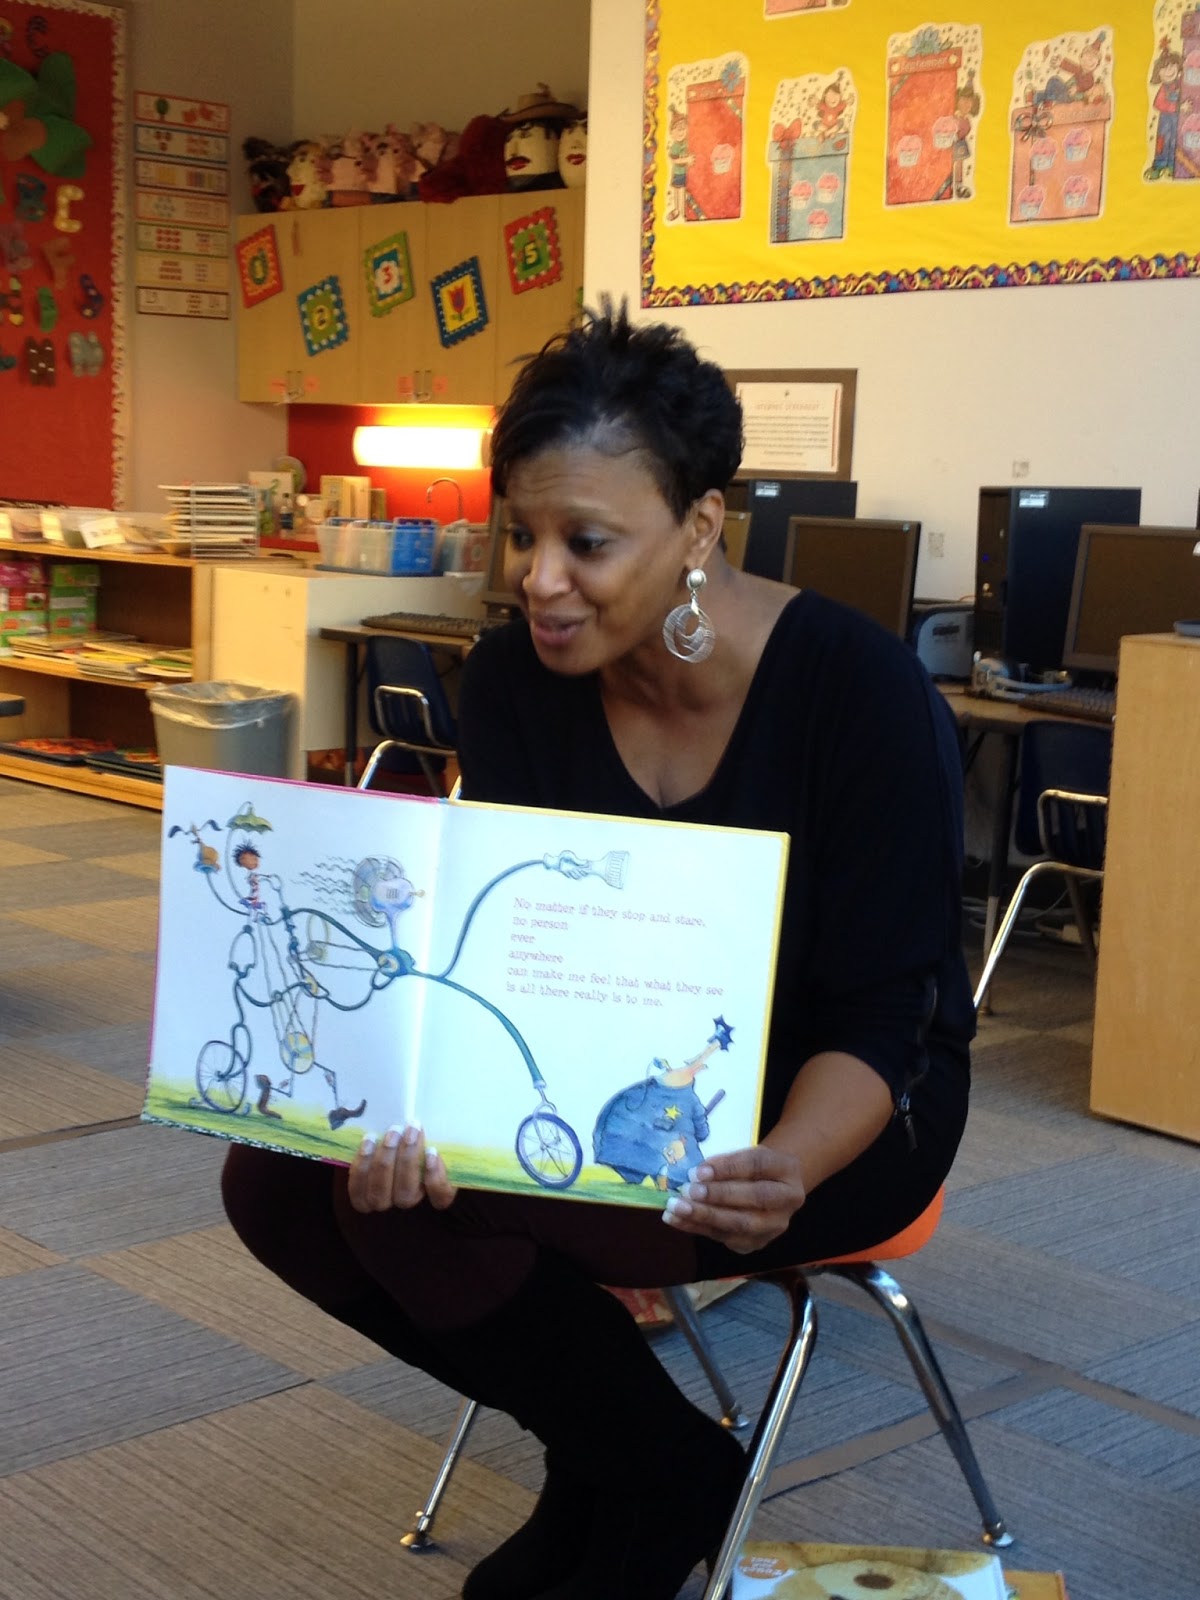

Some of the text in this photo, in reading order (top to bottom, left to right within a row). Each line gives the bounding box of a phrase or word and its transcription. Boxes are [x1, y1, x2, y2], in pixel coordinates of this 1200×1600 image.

[524, 242, 538, 265] 5
[381, 264, 393, 285] 3
[514, 897, 532, 910] No
[536, 902, 575, 914] matter
[579, 904, 589, 915] if
[592, 906, 618, 920] they
[622, 910, 646, 922] stop
[650, 913, 670, 923] and
[513, 916, 568, 930] no person
[511, 933, 536, 944] ever
[508, 950, 563, 963] anywhere
[507, 966, 724, 996] can make me feel that what they see
[506, 981, 516, 993] is
[520, 983, 535, 994] all
[540, 985, 570, 998] there
[574, 990, 608, 1003] really
[613, 992, 621, 1004] is
[626, 994, 638, 1004] to
